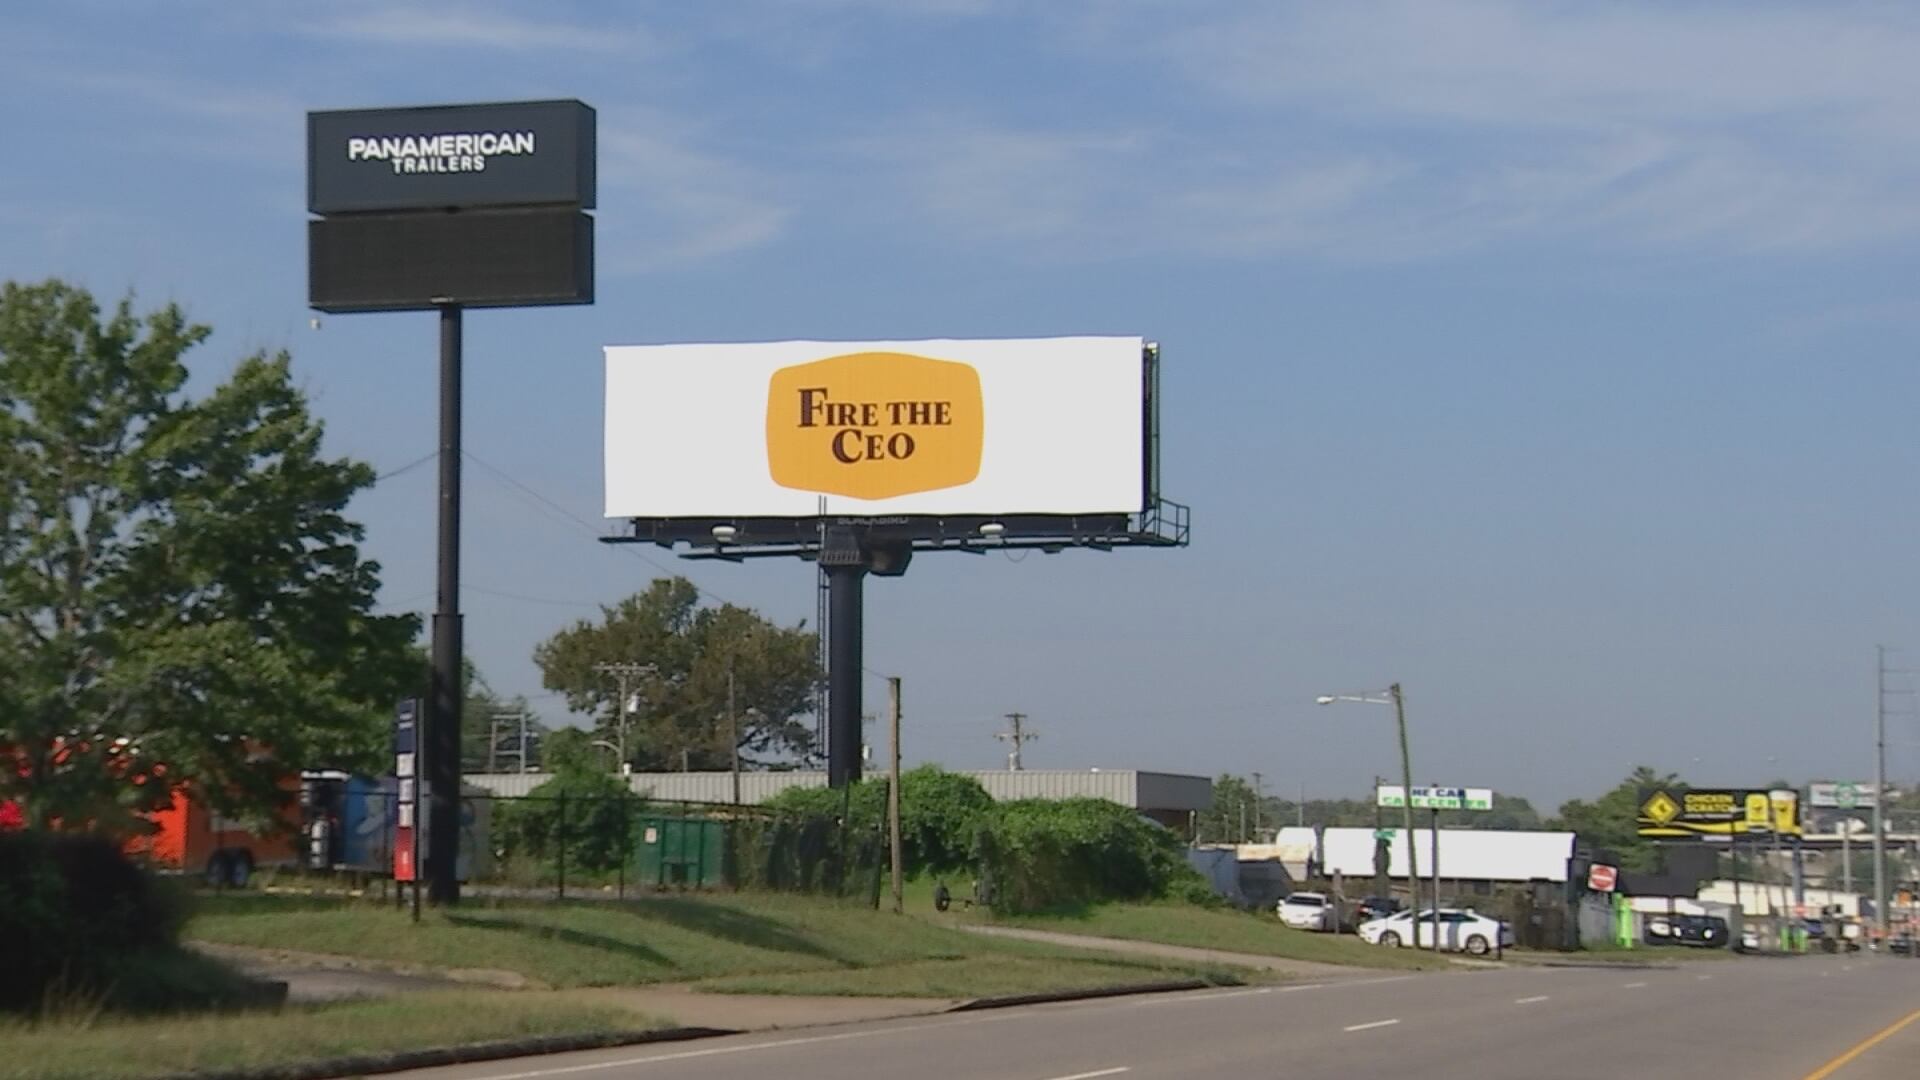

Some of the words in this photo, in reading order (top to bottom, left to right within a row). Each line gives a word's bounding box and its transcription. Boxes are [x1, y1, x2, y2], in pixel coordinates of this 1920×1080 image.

[348, 132, 534, 160] PANAMERICAN
[393, 155, 485, 173] TRAILERS
[797, 387, 879, 428] FIRE
[886, 401, 952, 426] THE
[831, 428, 916, 464] CEO
[1383, 796, 1420, 806] CAE
